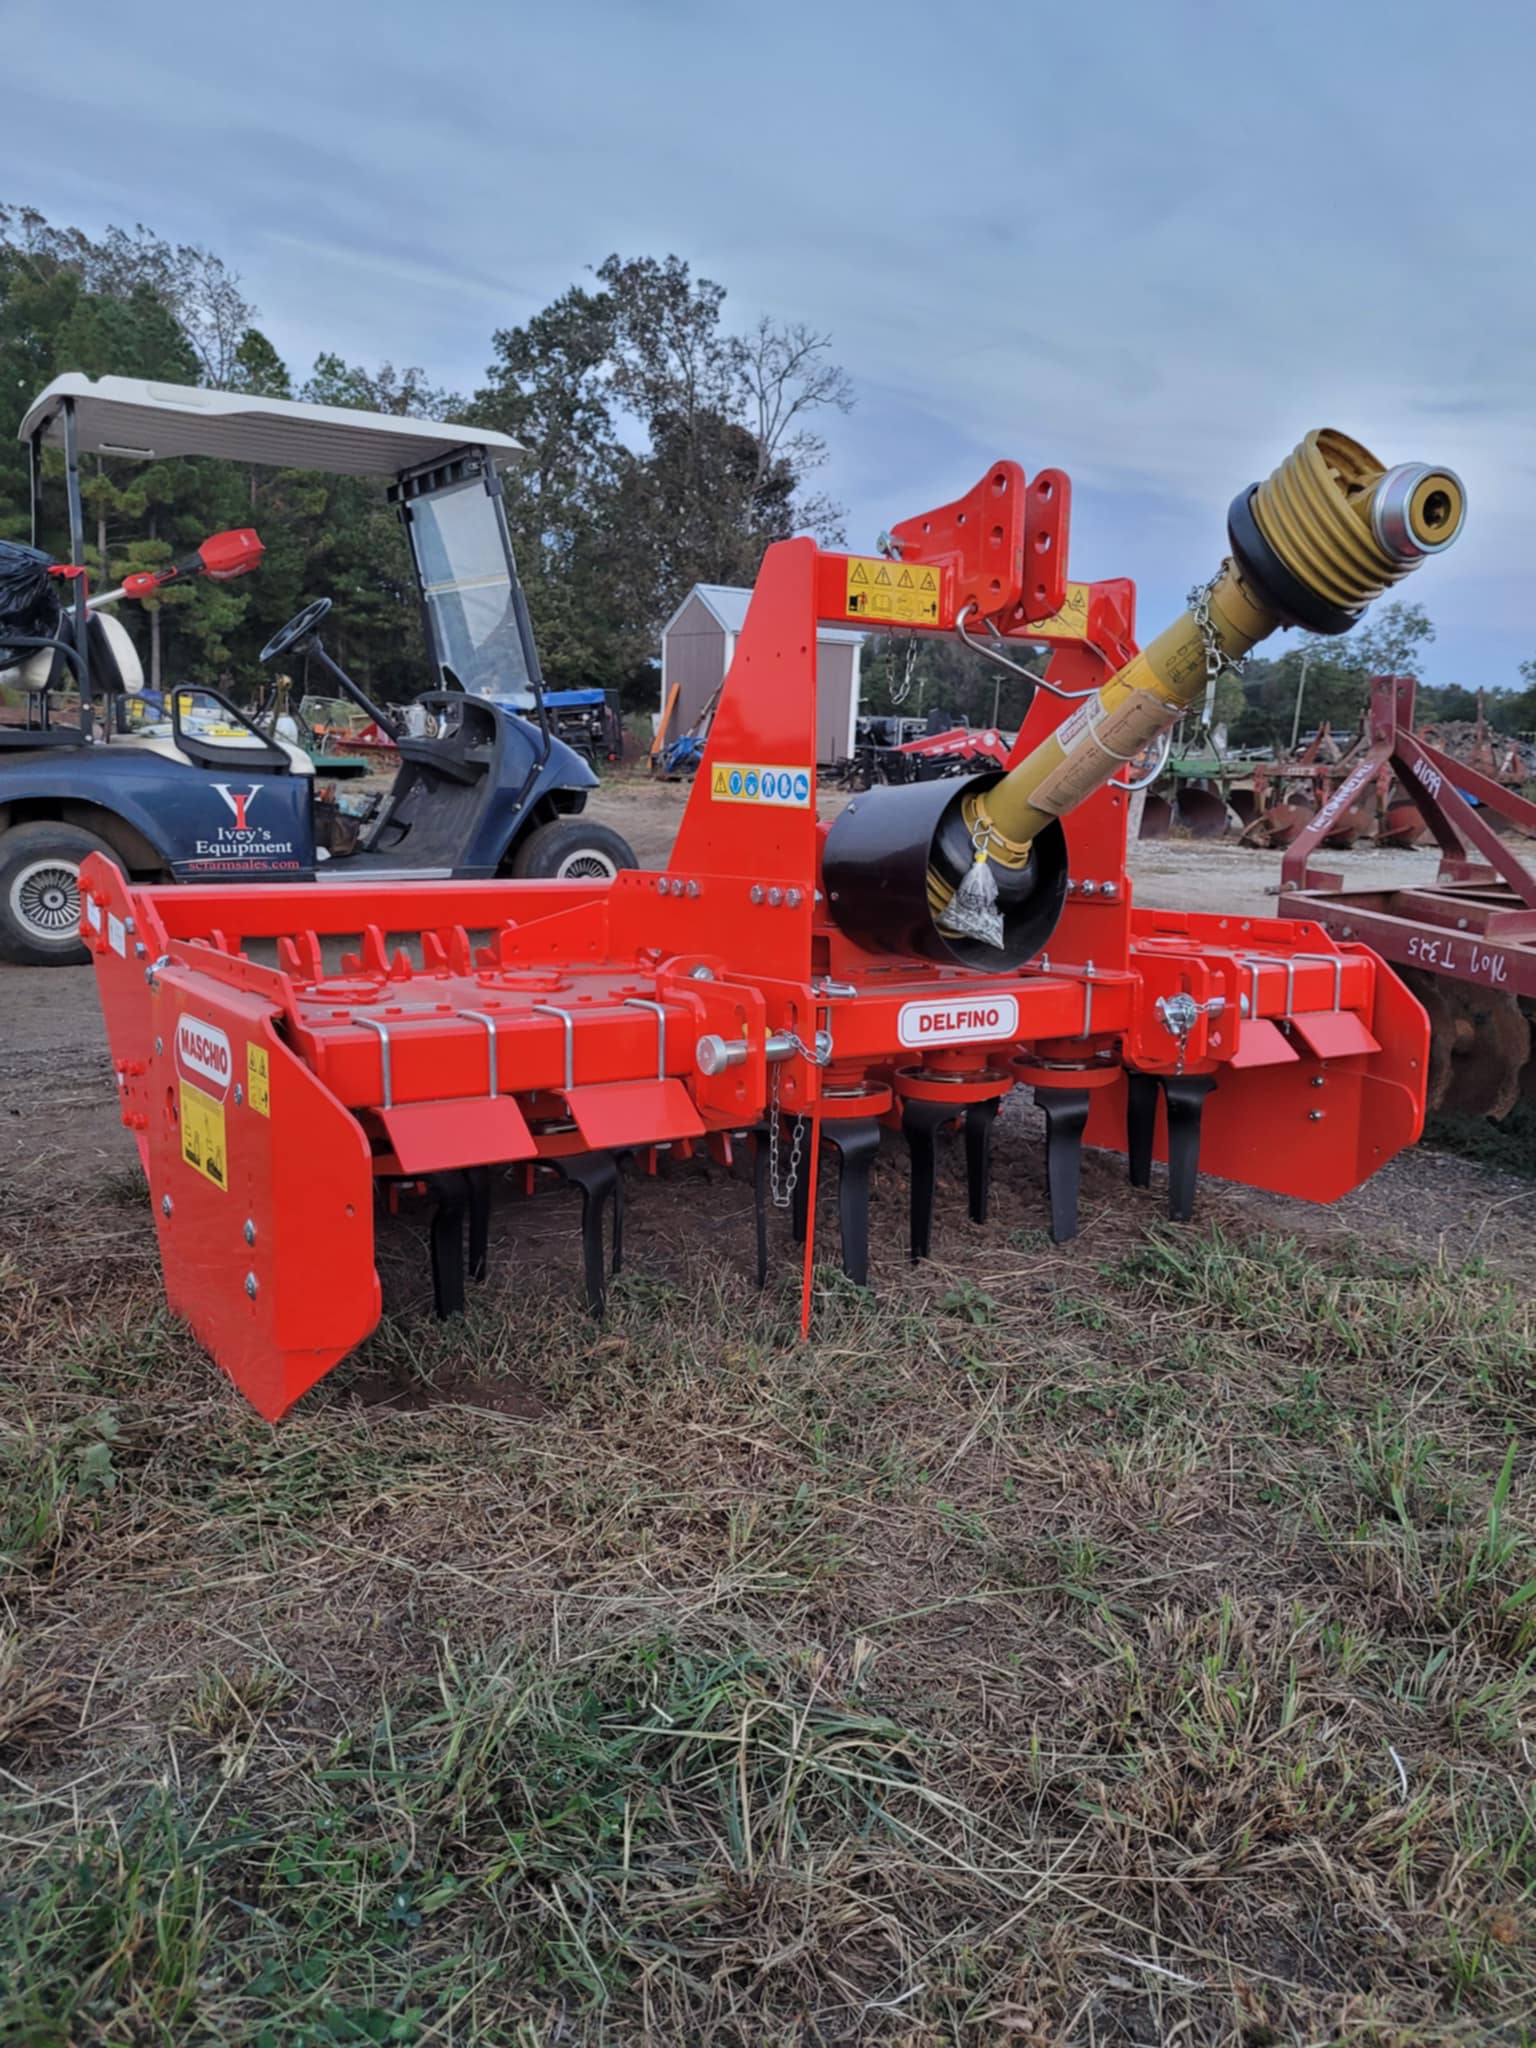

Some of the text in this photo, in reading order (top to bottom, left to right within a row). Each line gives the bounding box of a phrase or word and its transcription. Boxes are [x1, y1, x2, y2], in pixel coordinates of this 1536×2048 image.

[217, 827, 272, 844] Ivey's
[195, 840, 293, 857] Equipment
[188, 859, 300, 871] scfarmsales.com
[919, 1008, 1000, 1033] DELFINO
[180, 1026, 229, 1076] MASCHIO
